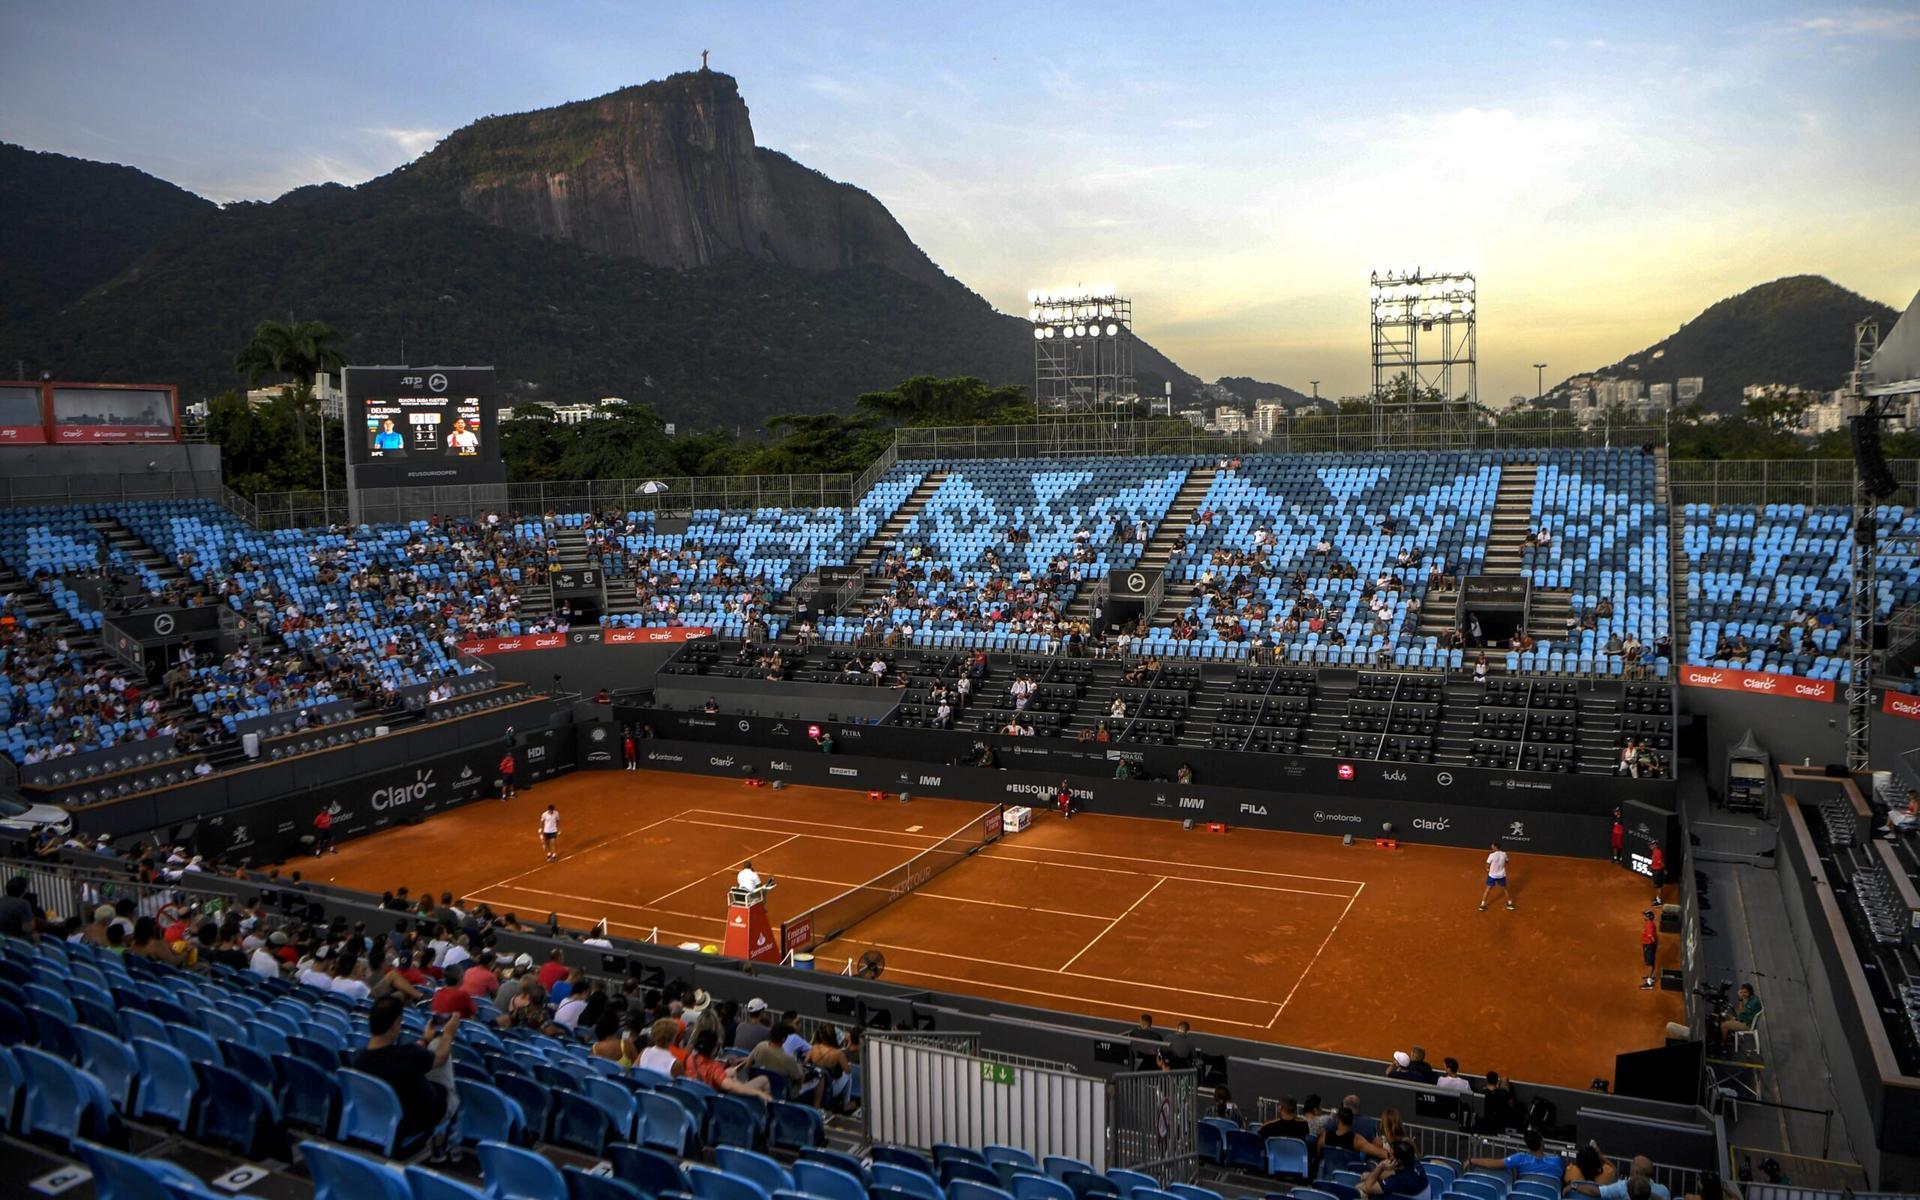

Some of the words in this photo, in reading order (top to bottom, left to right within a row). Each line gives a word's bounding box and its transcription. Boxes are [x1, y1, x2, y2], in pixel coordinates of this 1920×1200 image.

[401, 377, 422, 385] ATP
[536, 637, 559, 646] Claro
[612, 632, 635, 641] Claro
[649, 631, 672, 640] Claro
[498, 640, 521, 650] Claro
[1689, 672, 1722, 684] Claro
[1743, 677, 1776, 689] Claro
[1795, 684, 1825, 696] Claro
[1892, 701, 1920, 715] Claro
[527, 746, 545, 758] HDI
[710, 756, 734, 767] Claro
[919, 775, 941, 786] IMM
[371, 769, 437, 811] Claro
[1179, 797, 1204, 809] IMM
[1240, 803, 1267, 815] FILA
[1326, 813, 1361, 823] motorola
[1413, 817, 1450, 831] Claro
[1632, 860, 1648, 874] 155
[751, 943, 773, 958] Santander
